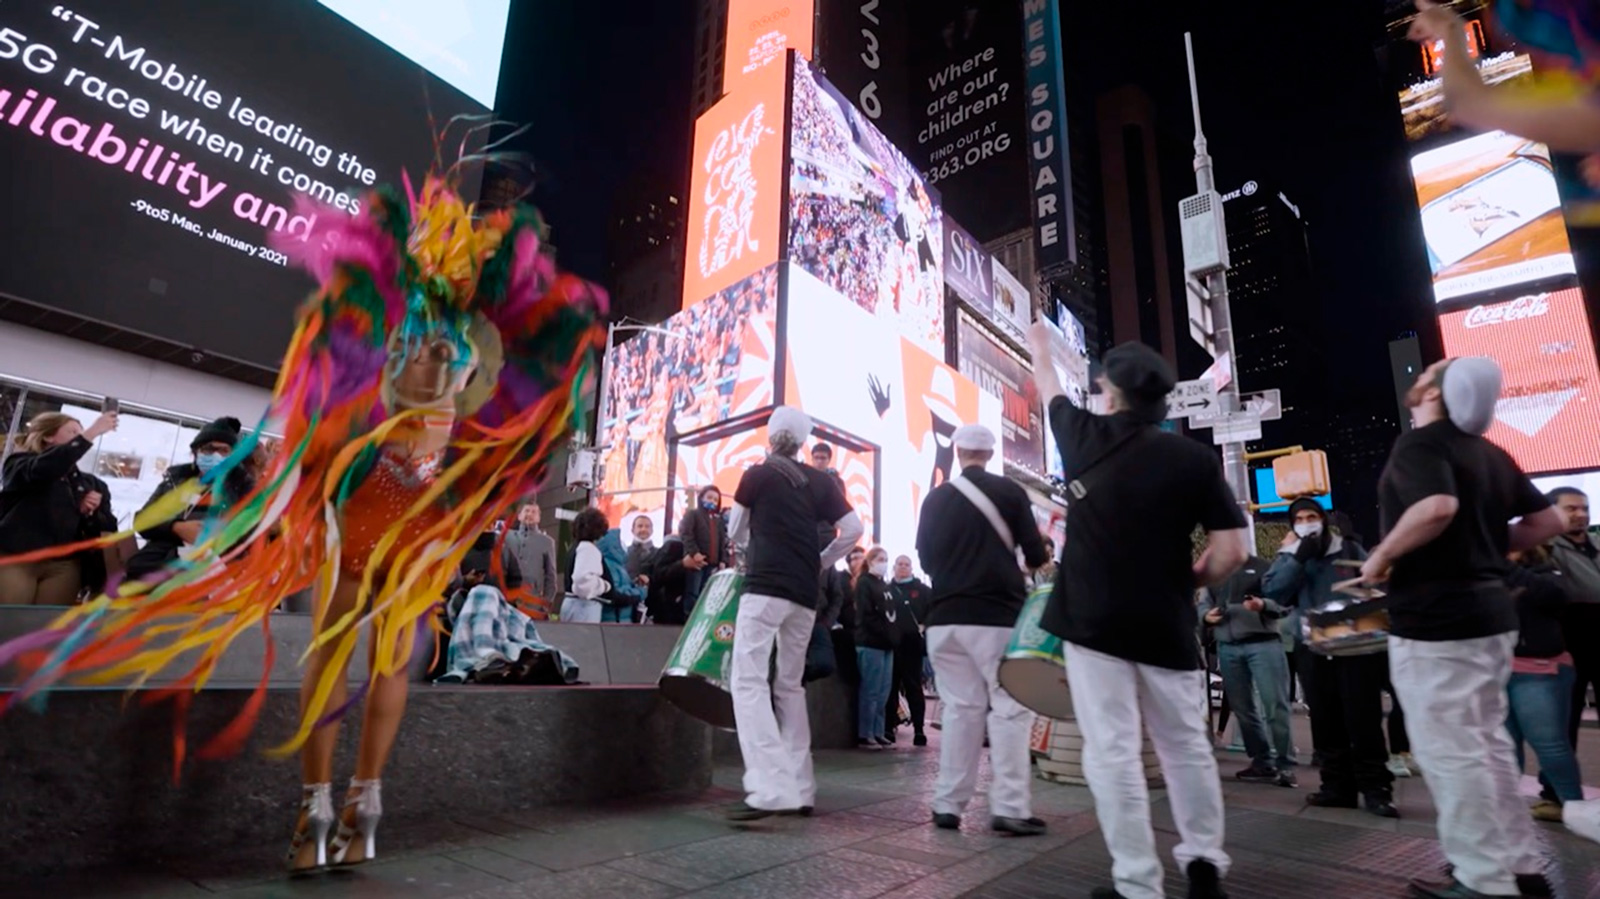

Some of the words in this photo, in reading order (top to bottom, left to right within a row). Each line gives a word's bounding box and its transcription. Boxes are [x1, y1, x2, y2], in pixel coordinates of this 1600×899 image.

[926, 89, 959, 116] are
[962, 67, 998, 96] our
[928, 46, 995, 93] Where
[0, 27, 57, 74] 5G
[63, 66, 150, 119] race
[159, 107, 244, 163] when
[249, 147, 276, 177] it
[277, 165, 361, 216] comes
[917, 82, 1010, 144] children?
[228, 96, 332, 168] leading
[337, 151, 378, 186] the
[929, 144, 955, 163] FIND
[956, 129, 980, 149] OUT
[983, 121, 998, 137] AT
[1031, 82, 1059, 248] SQUARE
[130, 199, 171, 222] -9to5
[171, 212, 204, 237] Mac,
[206, 228, 258, 257] January
[258, 246, 289, 267] 2021
[233, 191, 318, 243] and
[1463, 292, 1551, 329] Coca-Cola
[1186, 382, 1210, 397] ZONE
